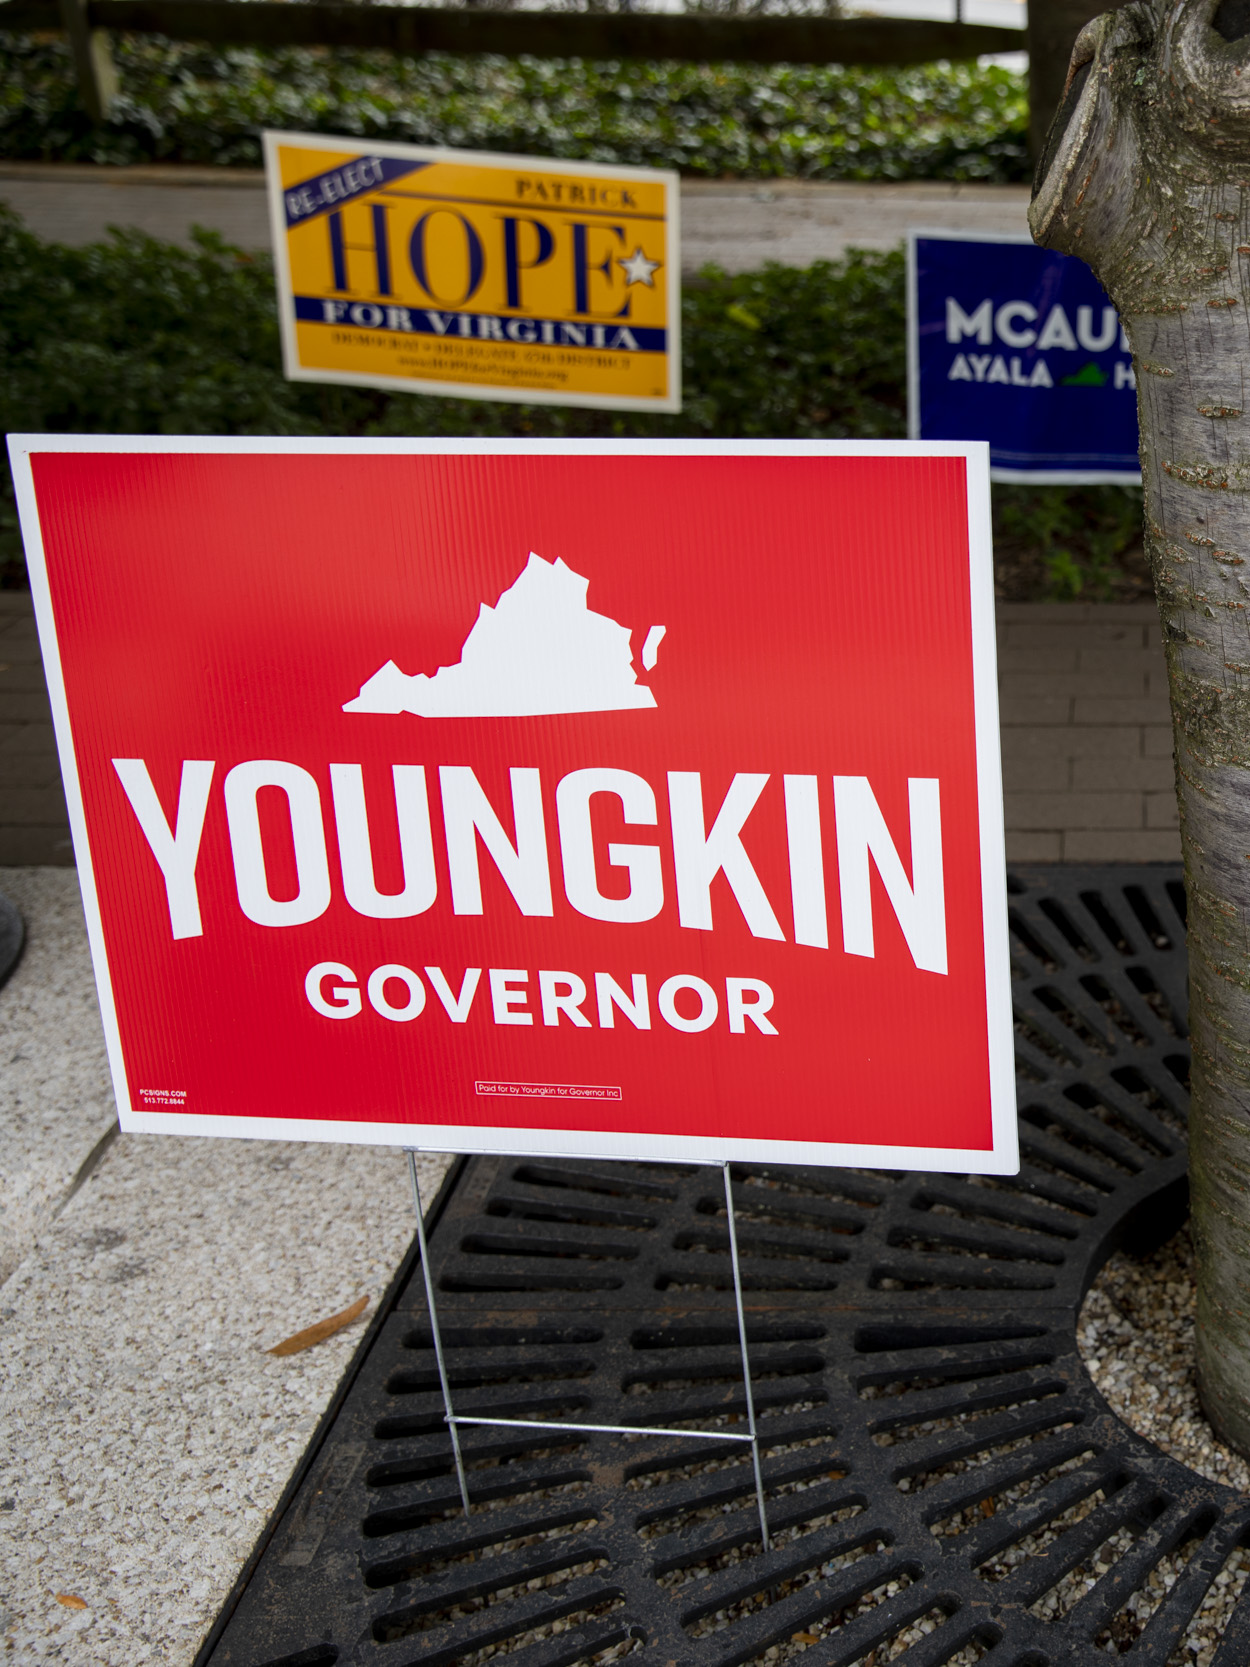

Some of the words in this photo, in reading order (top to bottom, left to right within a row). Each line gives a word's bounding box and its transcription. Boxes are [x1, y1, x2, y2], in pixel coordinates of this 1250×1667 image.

[286, 157, 384, 219] RE-ELECT
[515, 178, 637, 209] PATRICK
[328, 203, 631, 319] HOPE
[322, 300, 414, 332] FOR
[425, 309, 641, 350] VIRGINIA
[947, 352, 1054, 388] AYALA
[111, 757, 949, 976] YOUNGKIN
[304, 961, 779, 1035] GOVERNOR
[139, 1089, 187, 1097] PCSIGNS.COM
[479, 1084, 496, 1092] Paid
[498, 1084, 508, 1092] for
[510, 1085, 519, 1094] by
[521, 1086, 556, 1096] Youngkin
[557, 1087, 568, 1095] for
[569, 1088, 605, 1097] Governor
[606, 1089, 618, 1097] Inc
